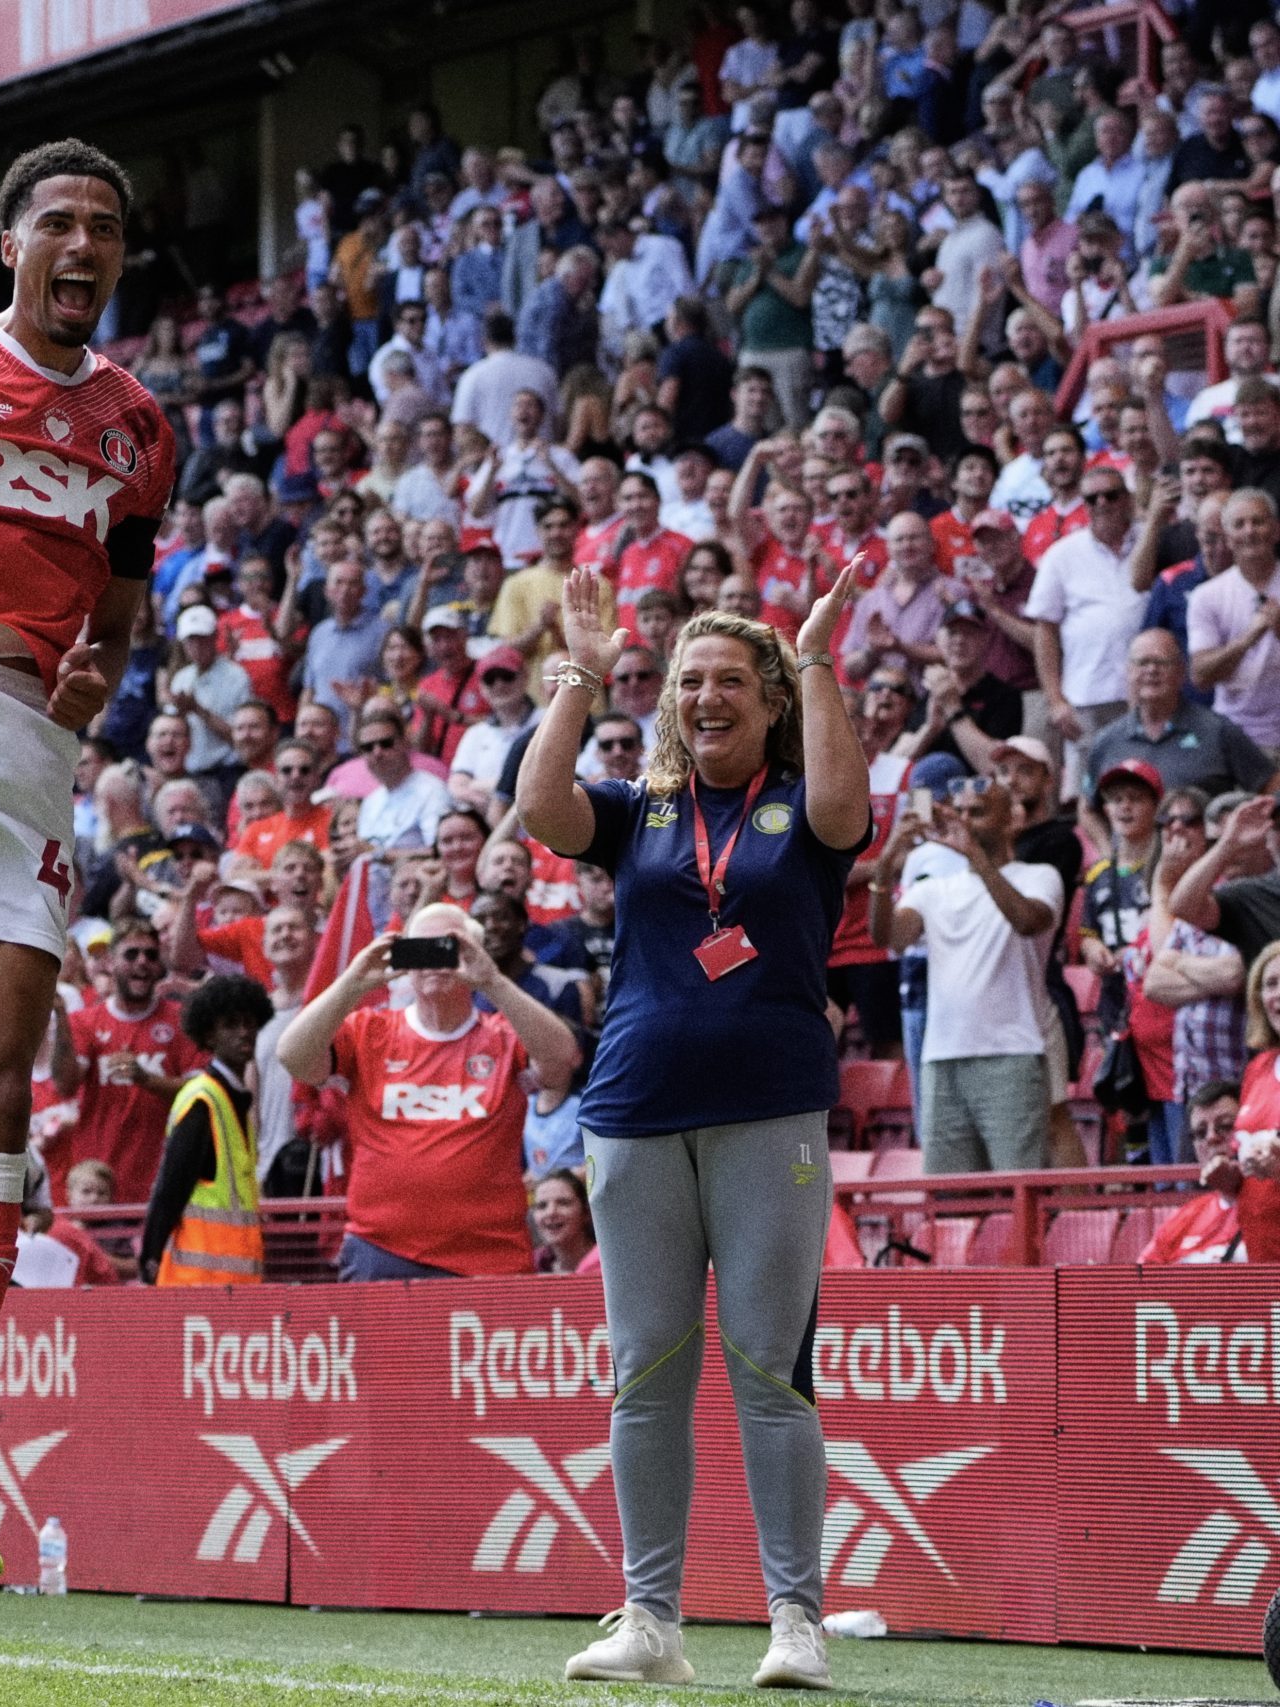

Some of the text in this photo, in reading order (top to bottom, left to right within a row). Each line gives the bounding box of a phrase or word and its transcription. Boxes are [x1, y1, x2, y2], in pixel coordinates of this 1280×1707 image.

[37, 839, 72, 909] 4
[382, 1083, 488, 1120] RSK
[800, 1144, 812, 1164] TL
[183, 1316, 357, 1415] Reebok
[450, 1307, 615, 1417] Reebo
[812, 1304, 1007, 1404] eebok
[1135, 1301, 1280, 1427] Ree
